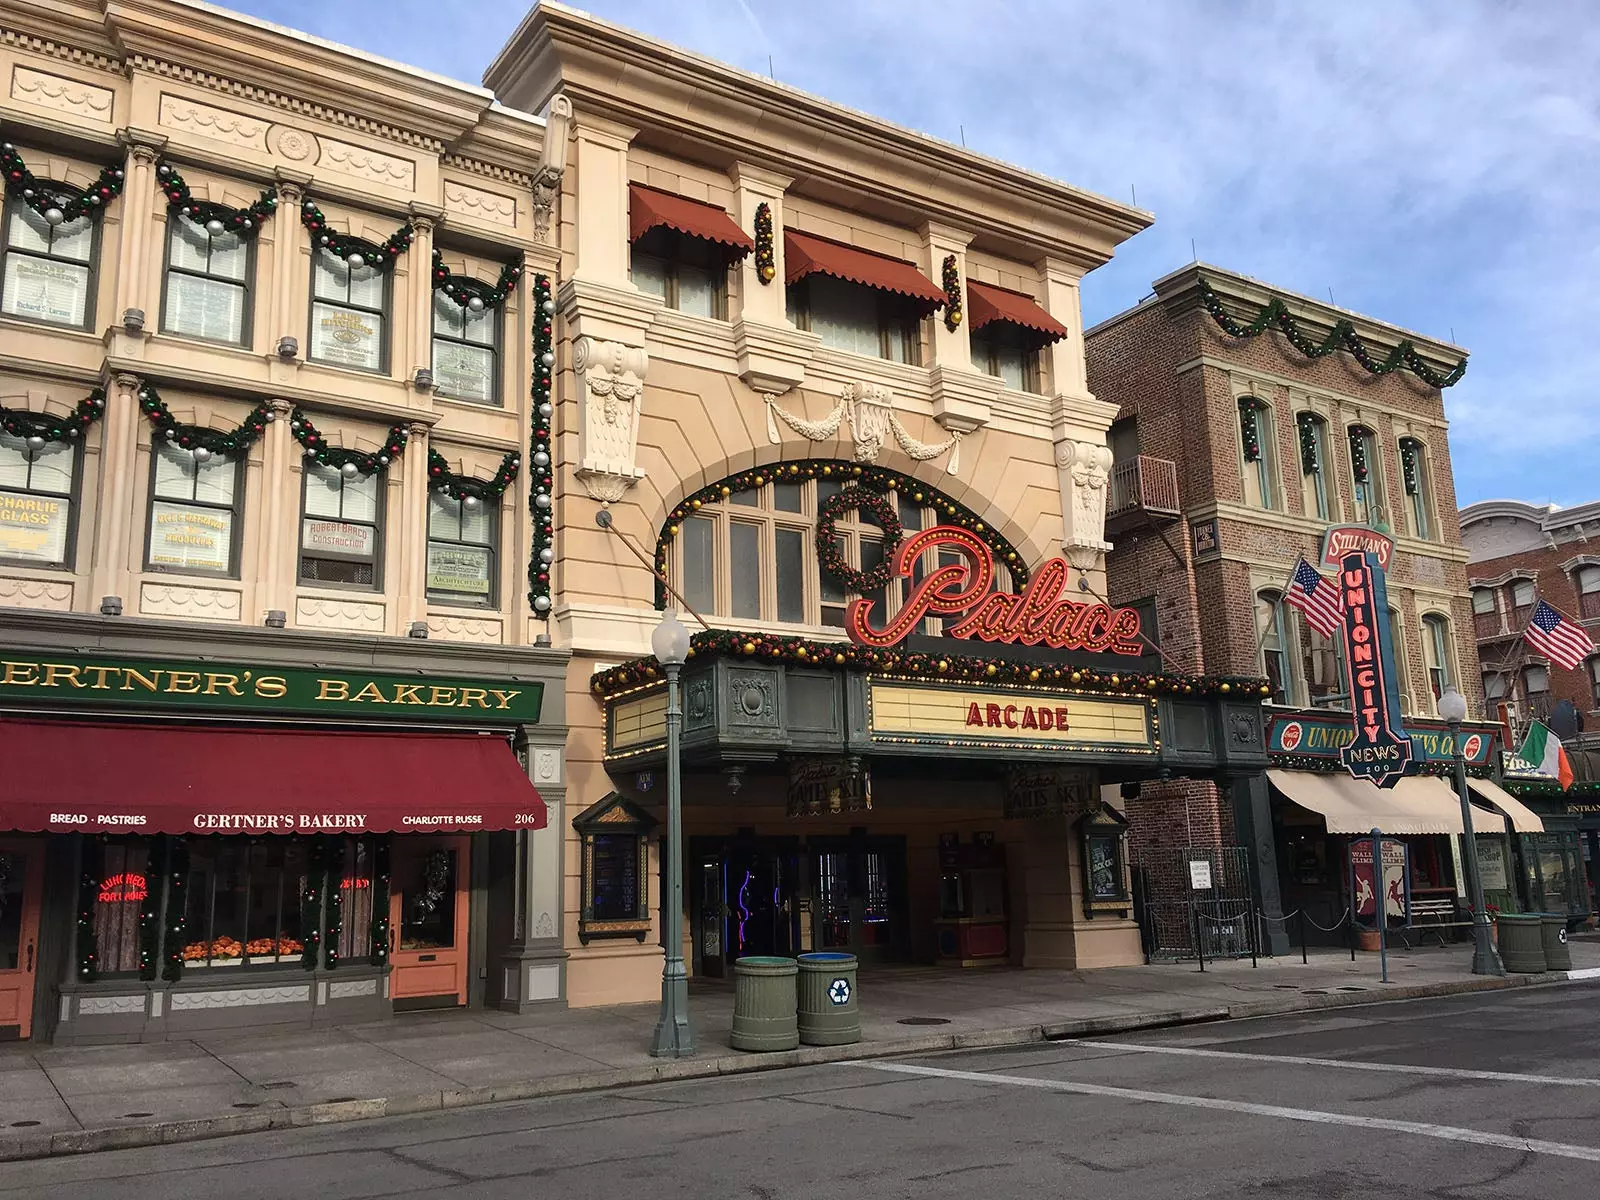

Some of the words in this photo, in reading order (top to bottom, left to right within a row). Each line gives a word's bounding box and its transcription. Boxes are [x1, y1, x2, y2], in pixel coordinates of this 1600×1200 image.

[1, 509, 49, 525] GLASS
[311, 523, 341, 533] ROBERT
[313, 535, 365, 549] CONSTRUCTION
[1329, 532, 1389, 564] STILLMAN'S
[846, 525, 1143, 656] Palace
[0, 660, 287, 698] ERTNER'S
[315, 680, 522, 709] BAKERY
[966, 702, 1070, 731] ARCADE
[1350, 745, 1400, 763] NEWS
[1366, 764, 1390, 774] 200
[50, 814, 87, 824] BREAD
[97, 815, 147, 825] PASTRIES
[193, 814, 294, 828] GERTNER'S
[299, 814, 367, 828] BAKERY
[402, 815, 453, 825] CHARLOTTE
[455, 815, 483, 824] RUSSE
[514, 813, 535, 824] 206
[99, 891, 116, 902] FOR
